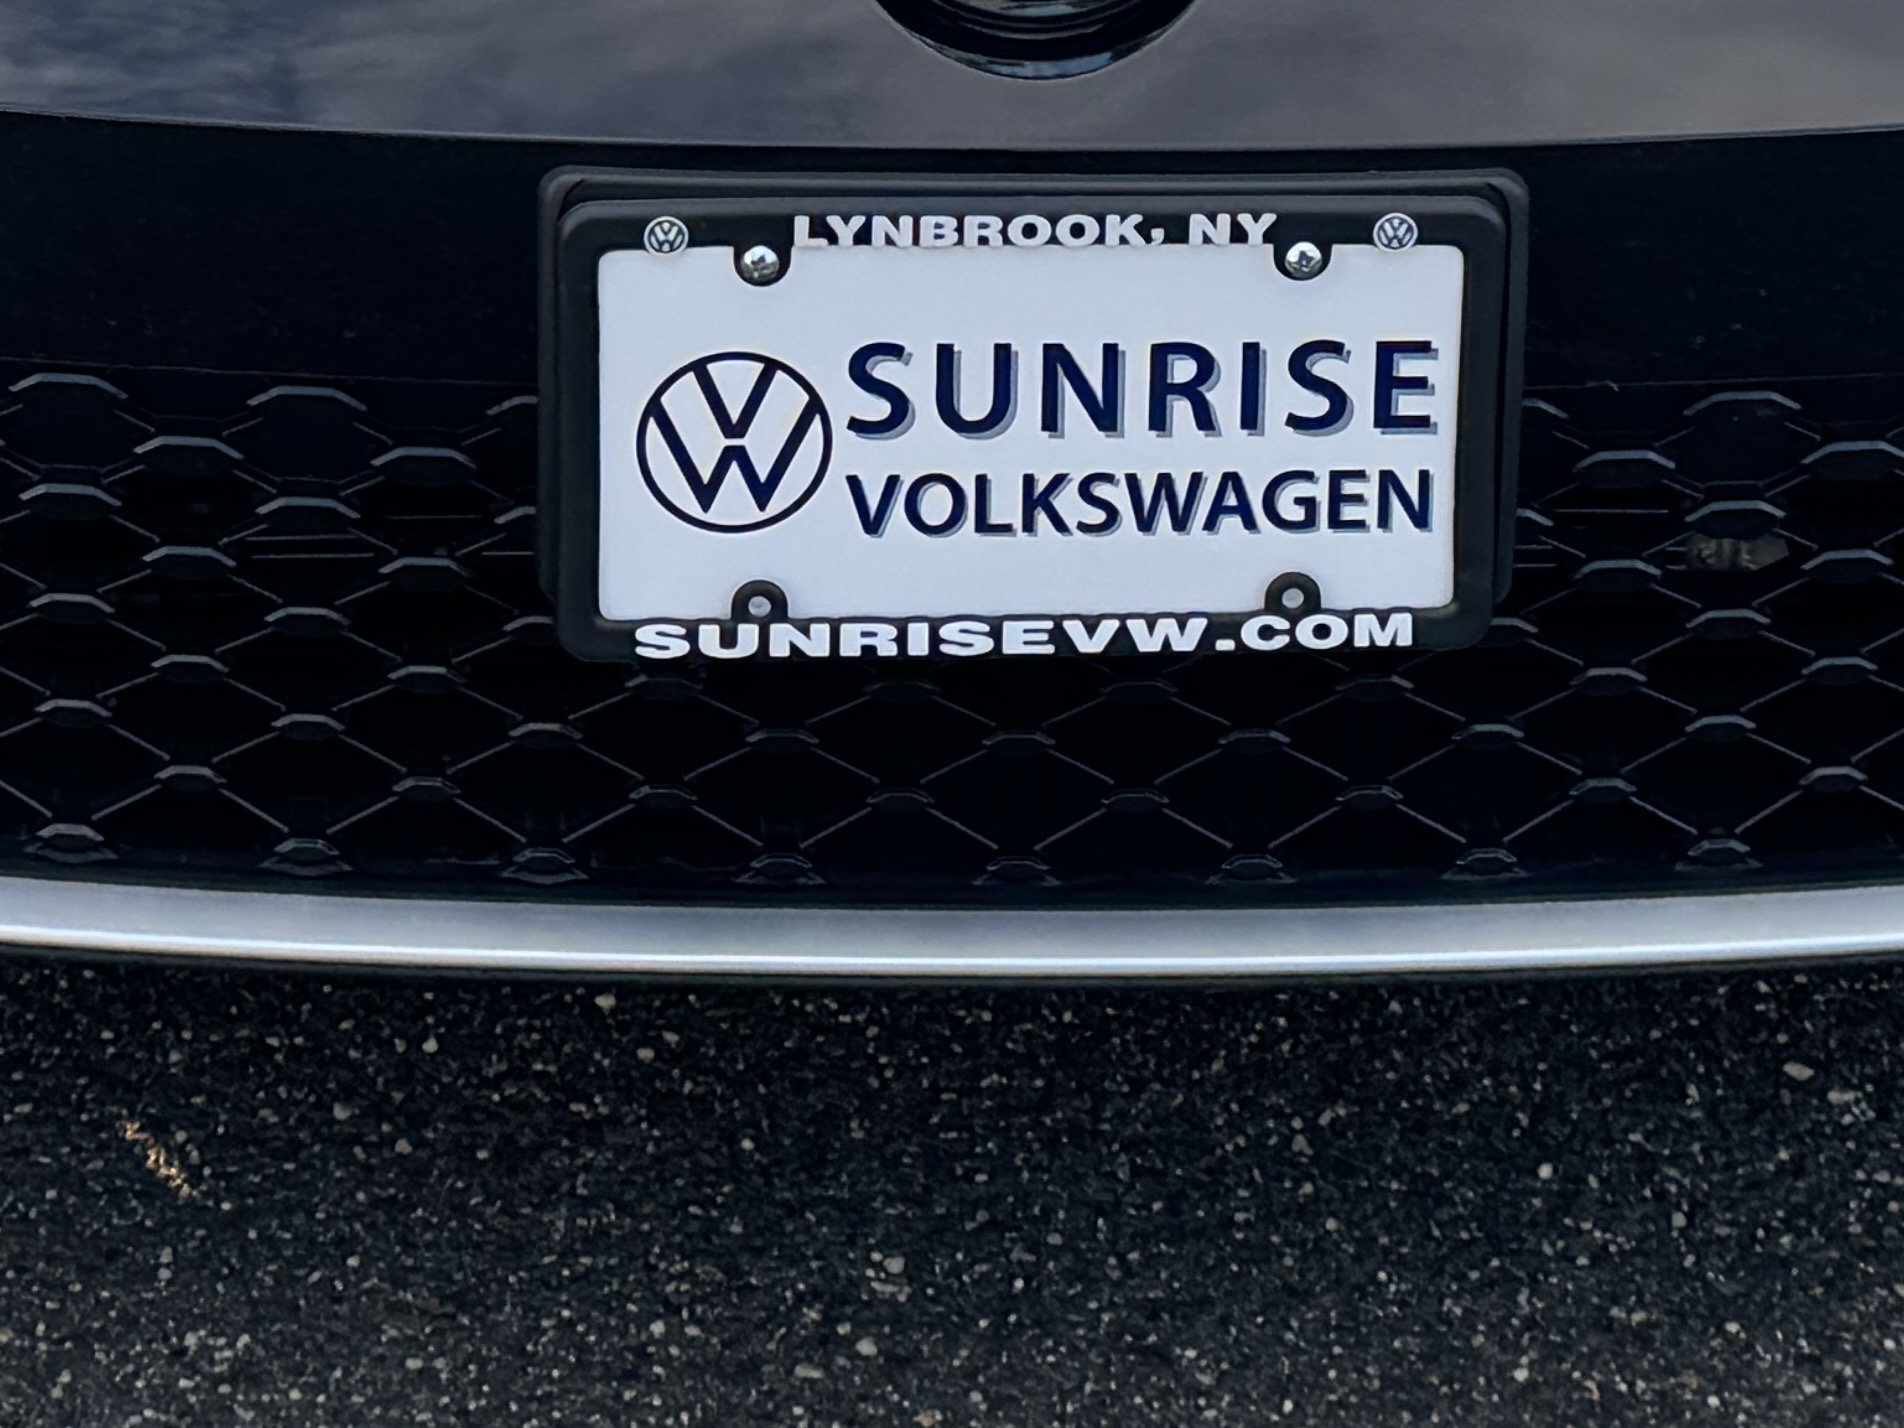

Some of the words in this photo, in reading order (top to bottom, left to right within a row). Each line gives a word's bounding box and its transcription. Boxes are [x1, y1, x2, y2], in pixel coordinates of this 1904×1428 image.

[793, 214, 1164, 248] LYNBROOK,
[1189, 212, 1277, 245] NY
[846, 340, 1439, 440] SUNRISE
[637, 351, 833, 533] VW
[846, 469, 1433, 537] VOLKSWAGEN
[635, 612, 1414, 660] SUNRISEVW.COM
